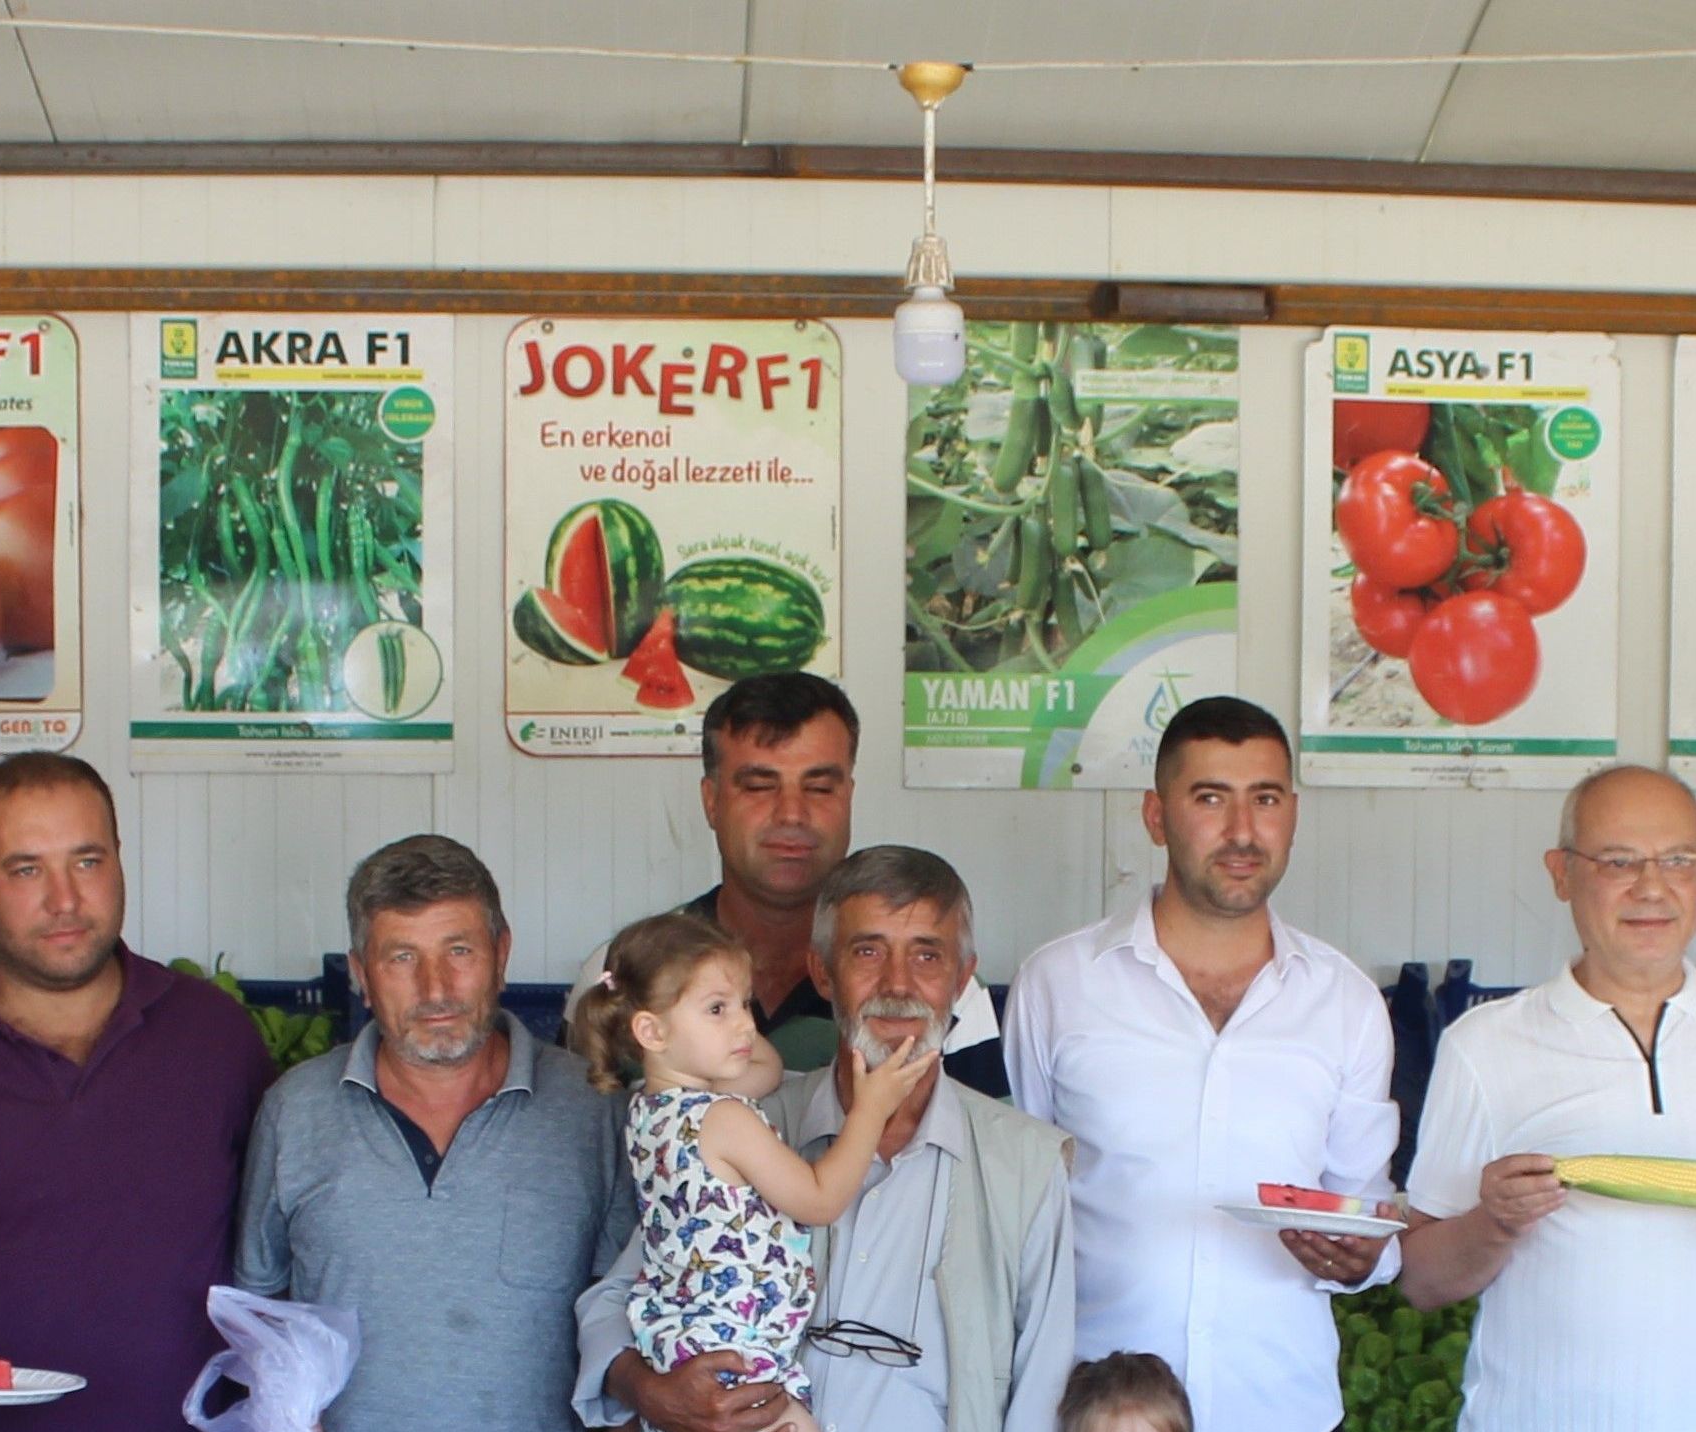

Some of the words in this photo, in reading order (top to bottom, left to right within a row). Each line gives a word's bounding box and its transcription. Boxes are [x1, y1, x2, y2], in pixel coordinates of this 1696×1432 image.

[215, 331, 348, 365] AKRA
[367, 331, 410, 365] F1
[519, 341, 748, 416] JOKER
[756, 354, 823, 411] F1
[1388, 349, 1483, 380] ASYA
[1498, 352, 1534, 380] F1
[540, 422, 575, 448] En
[582, 422, 671, 448] erkenci
[580, 464, 607, 482] ve
[611, 457, 679, 490] doğal
[685, 457, 761, 483] lezzeti
[767, 457, 815, 484] ile...
[922, 679, 1030, 711] YAMAN
[1046, 680, 1076, 711] F1
